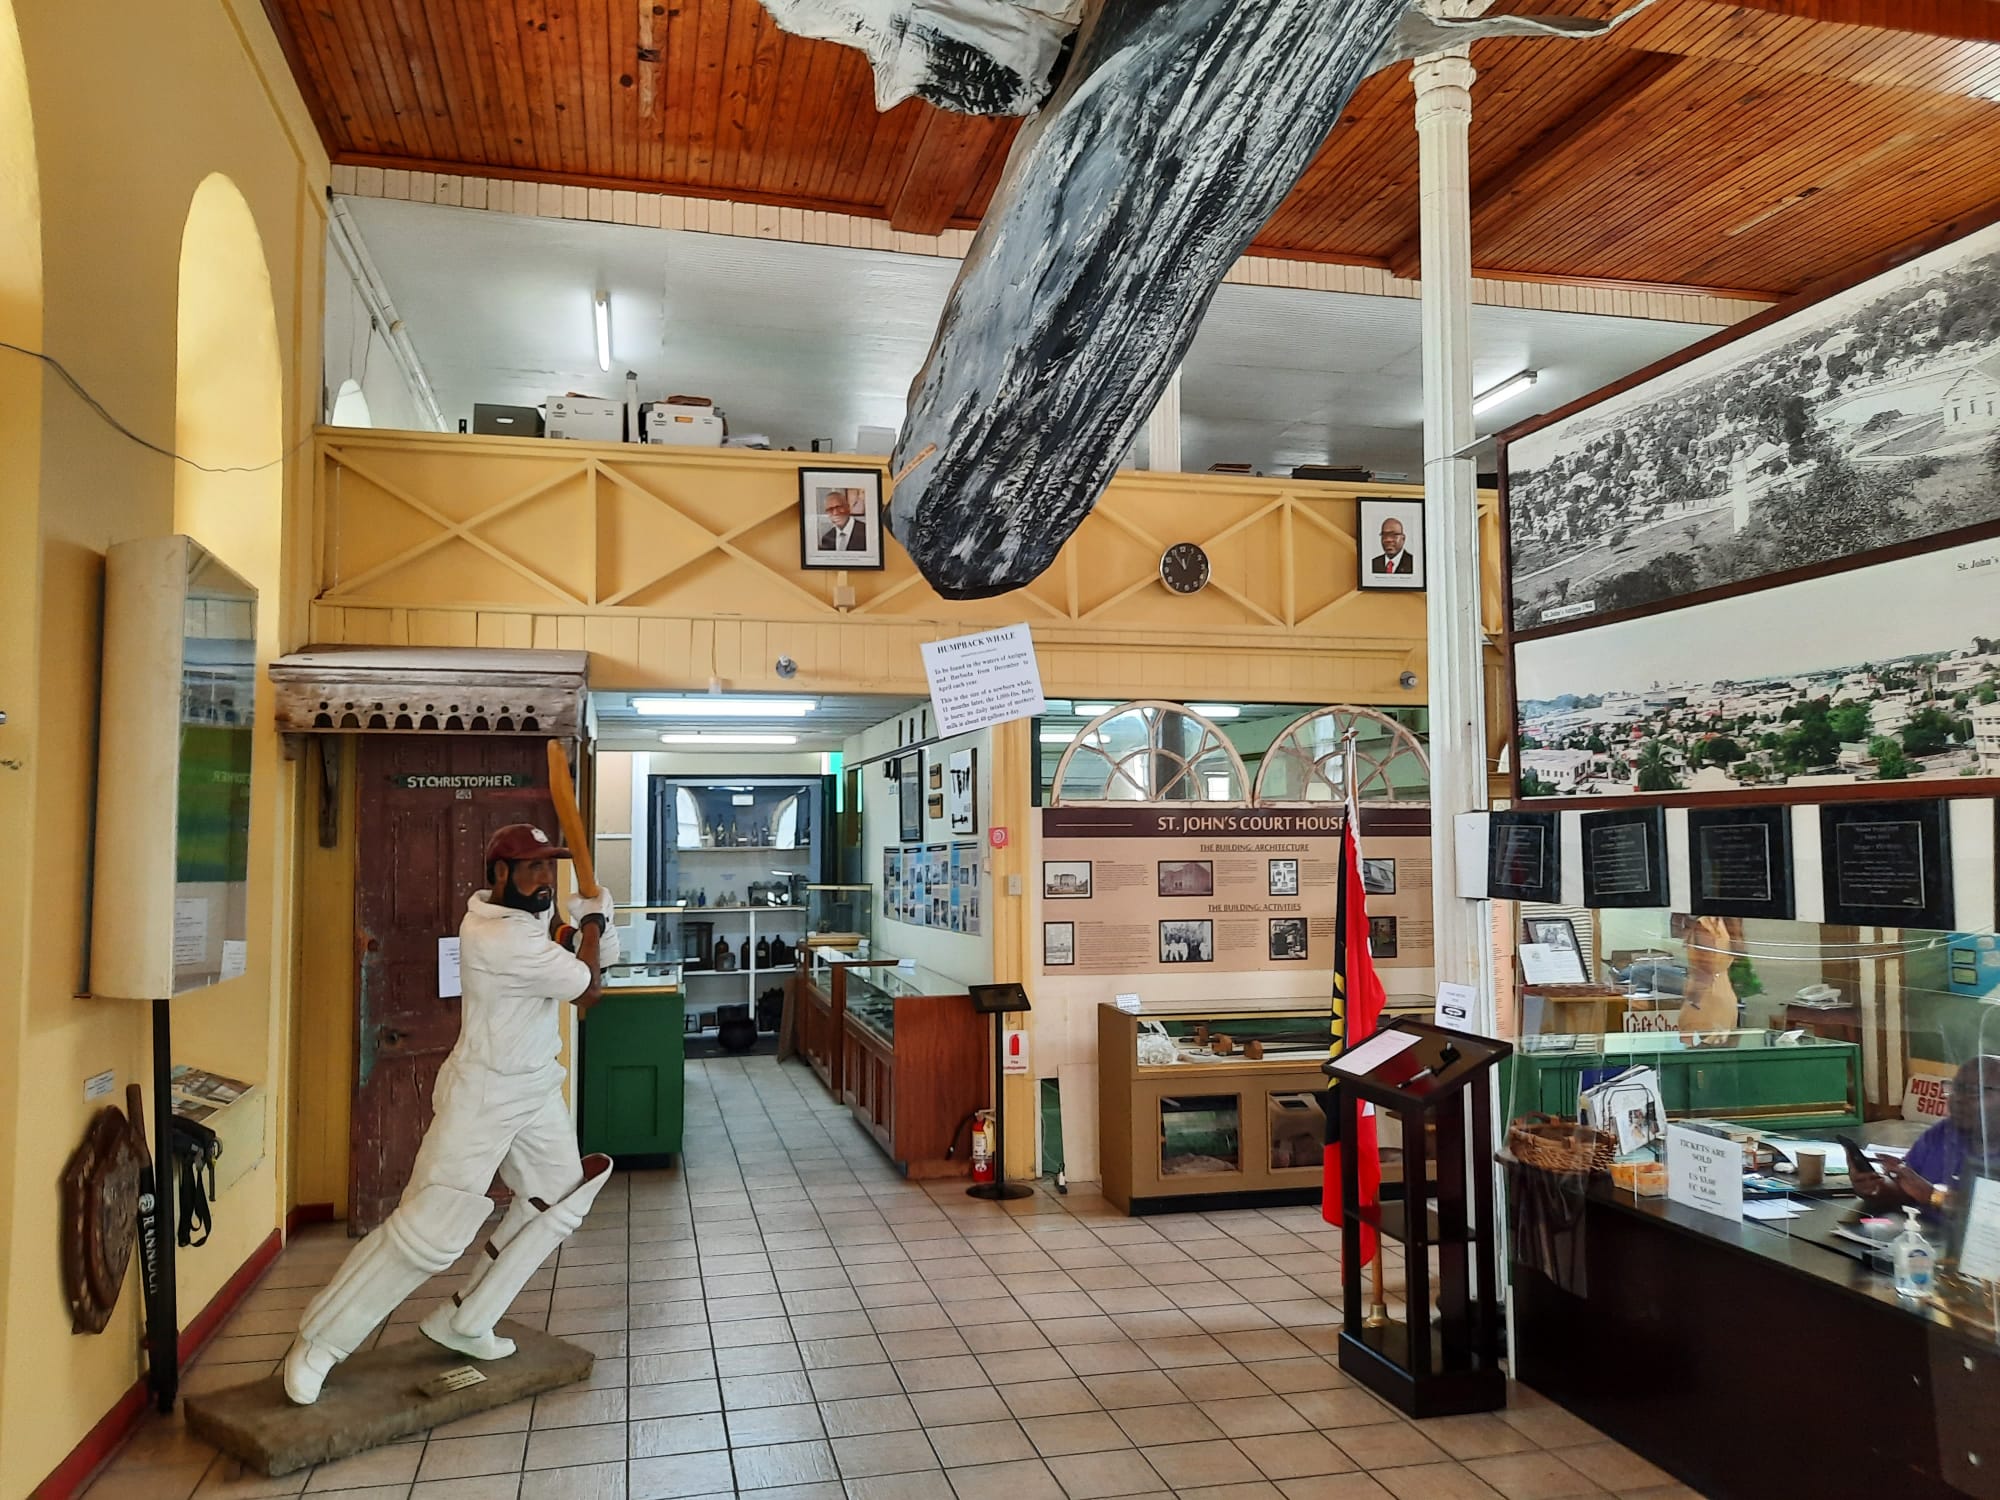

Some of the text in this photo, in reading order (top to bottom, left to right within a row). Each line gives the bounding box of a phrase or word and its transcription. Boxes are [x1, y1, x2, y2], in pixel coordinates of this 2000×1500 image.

[937, 637, 984, 654] HUMPBACK
[986, 632, 1015, 644] WHALE
[950, 664, 965, 672] found
[973, 660, 981, 668] the
[982, 657, 1000, 665] waters
[1008, 652, 1027, 660] Antigua
[950, 672, 974, 681] Barbuda
[994, 662, 1020, 672] December
[939, 684, 952, 693] April
[993, 684, 1015, 692] newborn
[950, 702, 970, 712] months
[964, 718, 980, 726] about
[988, 712, 1005, 720] gallons
[1158, 816, 1180, 830] ST.
[1182, 816, 1236, 834] JOHN'S
[1240, 816, 1292, 830] COURT
[1200, 844, 1214, 852] THE
[1254, 844, 1310, 852] ARCHITECTURE
[1208, 904, 1220, 912] THE
[1264, 904, 1302, 912] ACTIVITIES
[1655, 1014, 1679, 1032] Sho
[1917, 1096, 1946, 1116] SHO
[1680, 1140, 1726, 1158] TICKETS ARE
[1692, 1154, 1712, 1164] SOLD
[1688, 1172, 1698, 1180] US
